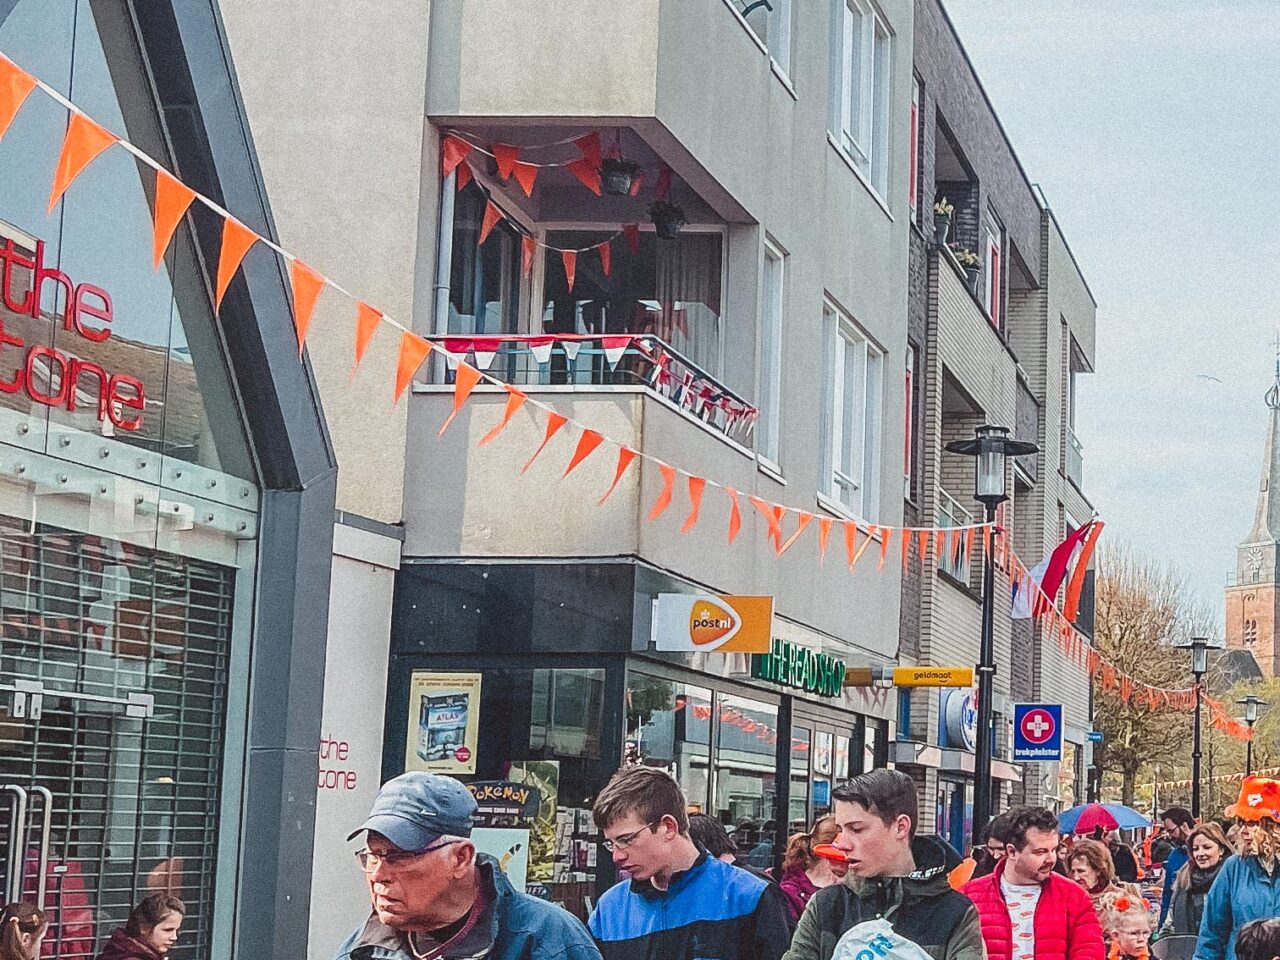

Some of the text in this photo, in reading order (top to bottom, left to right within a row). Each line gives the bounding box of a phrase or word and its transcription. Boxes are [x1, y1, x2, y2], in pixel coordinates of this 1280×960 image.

[0, 239, 113, 342] the
[692, 617, 731, 631] postnl
[788, 641, 818, 692] READ
[818, 652, 847, 699] SHOP
[913, 671, 953, 681] geldmaat
[436, 712, 460, 722] ATLAS
[319, 733, 349, 761] the
[1015, 747, 1060, 758] trekpleister
